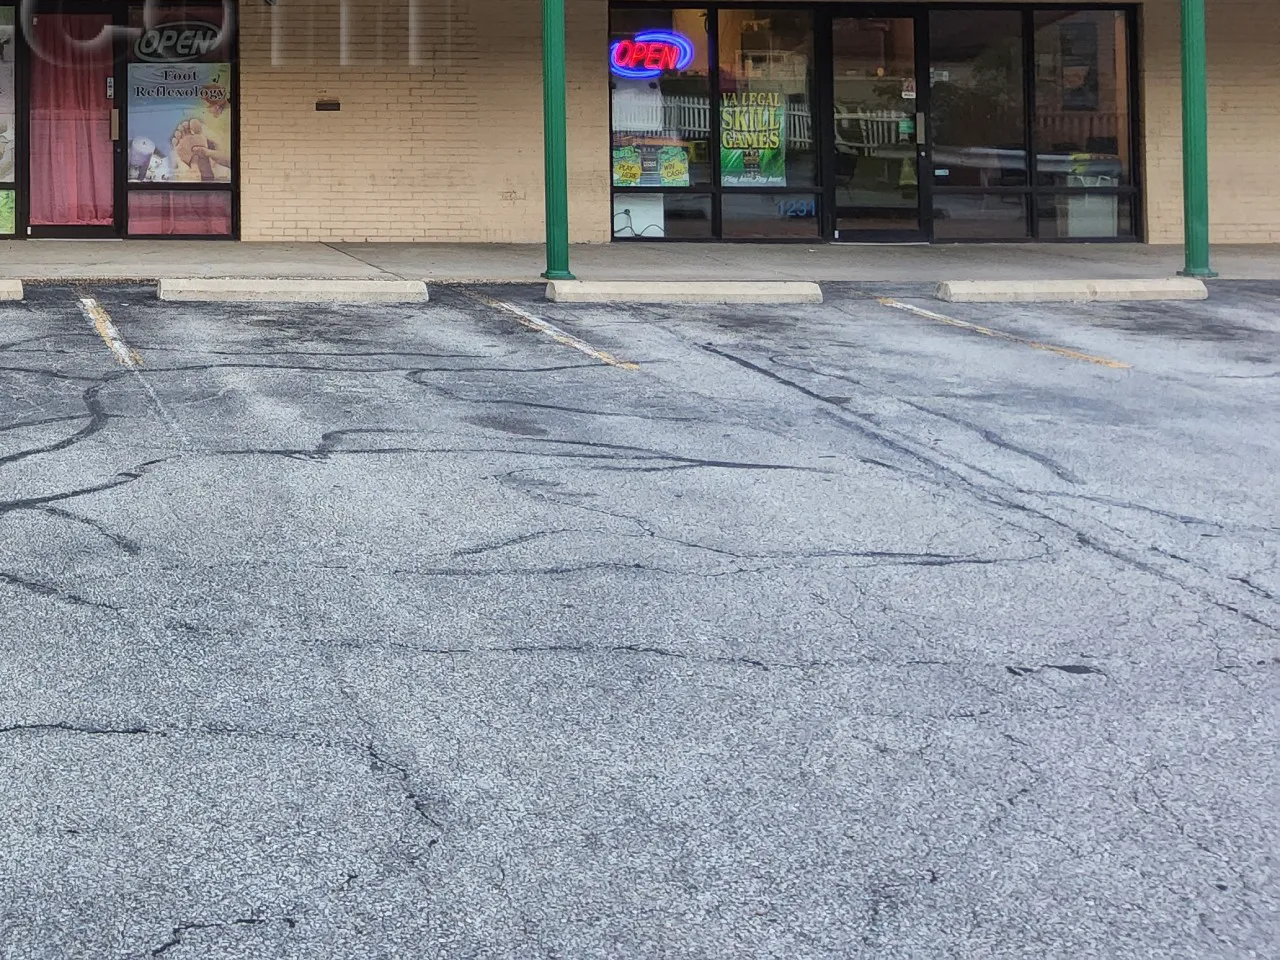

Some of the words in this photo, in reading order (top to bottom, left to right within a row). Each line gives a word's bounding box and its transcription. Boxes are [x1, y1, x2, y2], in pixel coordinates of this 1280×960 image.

[140, 30, 212, 54] OPEN
[615, 40, 680, 69] OPEN
[163, 70, 197, 81] Foot
[136, 86, 225, 99] Reflexology
[722, 92, 738, 106] VA
[741, 92, 780, 106] LEGAL
[721, 106, 780, 131] SKILL
[722, 131, 779, 148] GAMES
[778, 200, 815, 216] 1231
